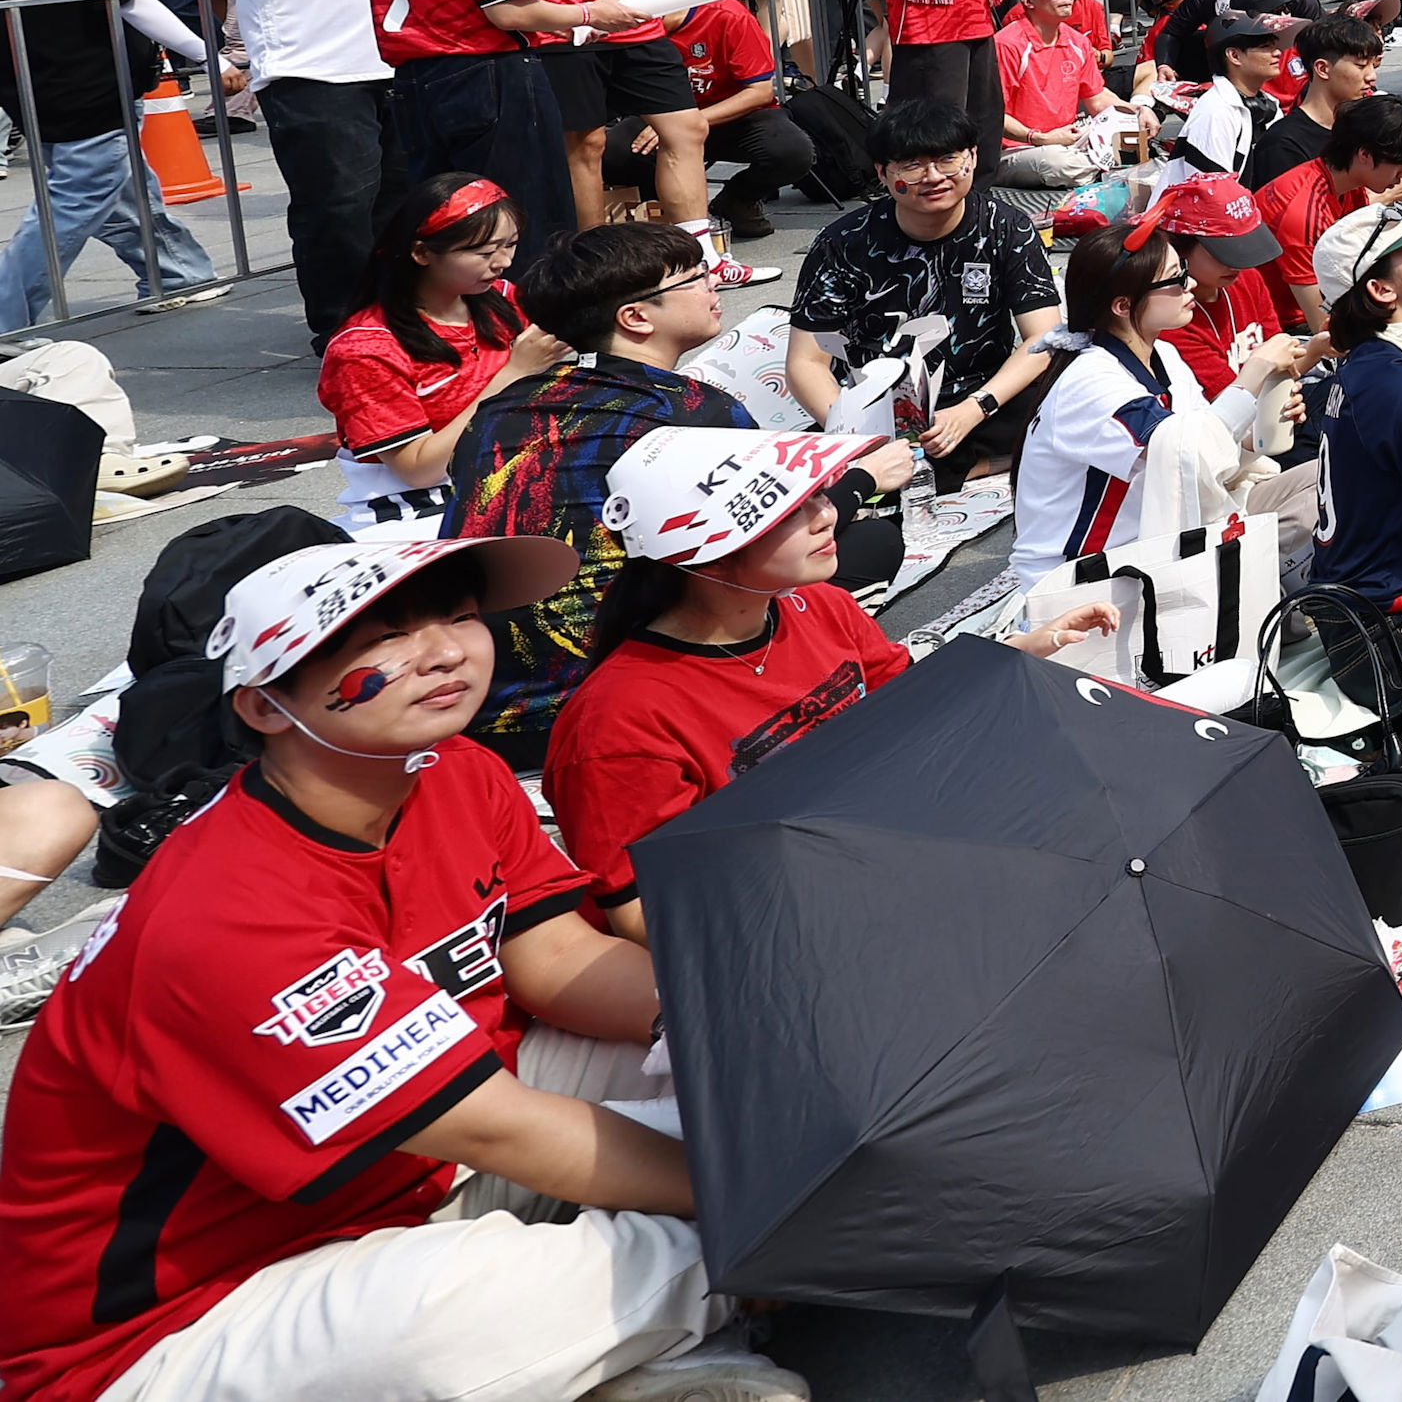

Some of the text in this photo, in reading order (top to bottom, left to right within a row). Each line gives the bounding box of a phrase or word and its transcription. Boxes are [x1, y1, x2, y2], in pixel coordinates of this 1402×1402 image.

[723, 267, 739, 282] 90
[962, 297, 990, 306] KOREA
[696, 454, 743, 497] KT
[303, 558, 359, 598] KT
[1192, 643, 1217, 672] kt
[263, 956, 383, 1037] TIGERS
[347, 988, 372, 1010] CLUB
[294, 1003, 460, 1125] MEDIHEAL
